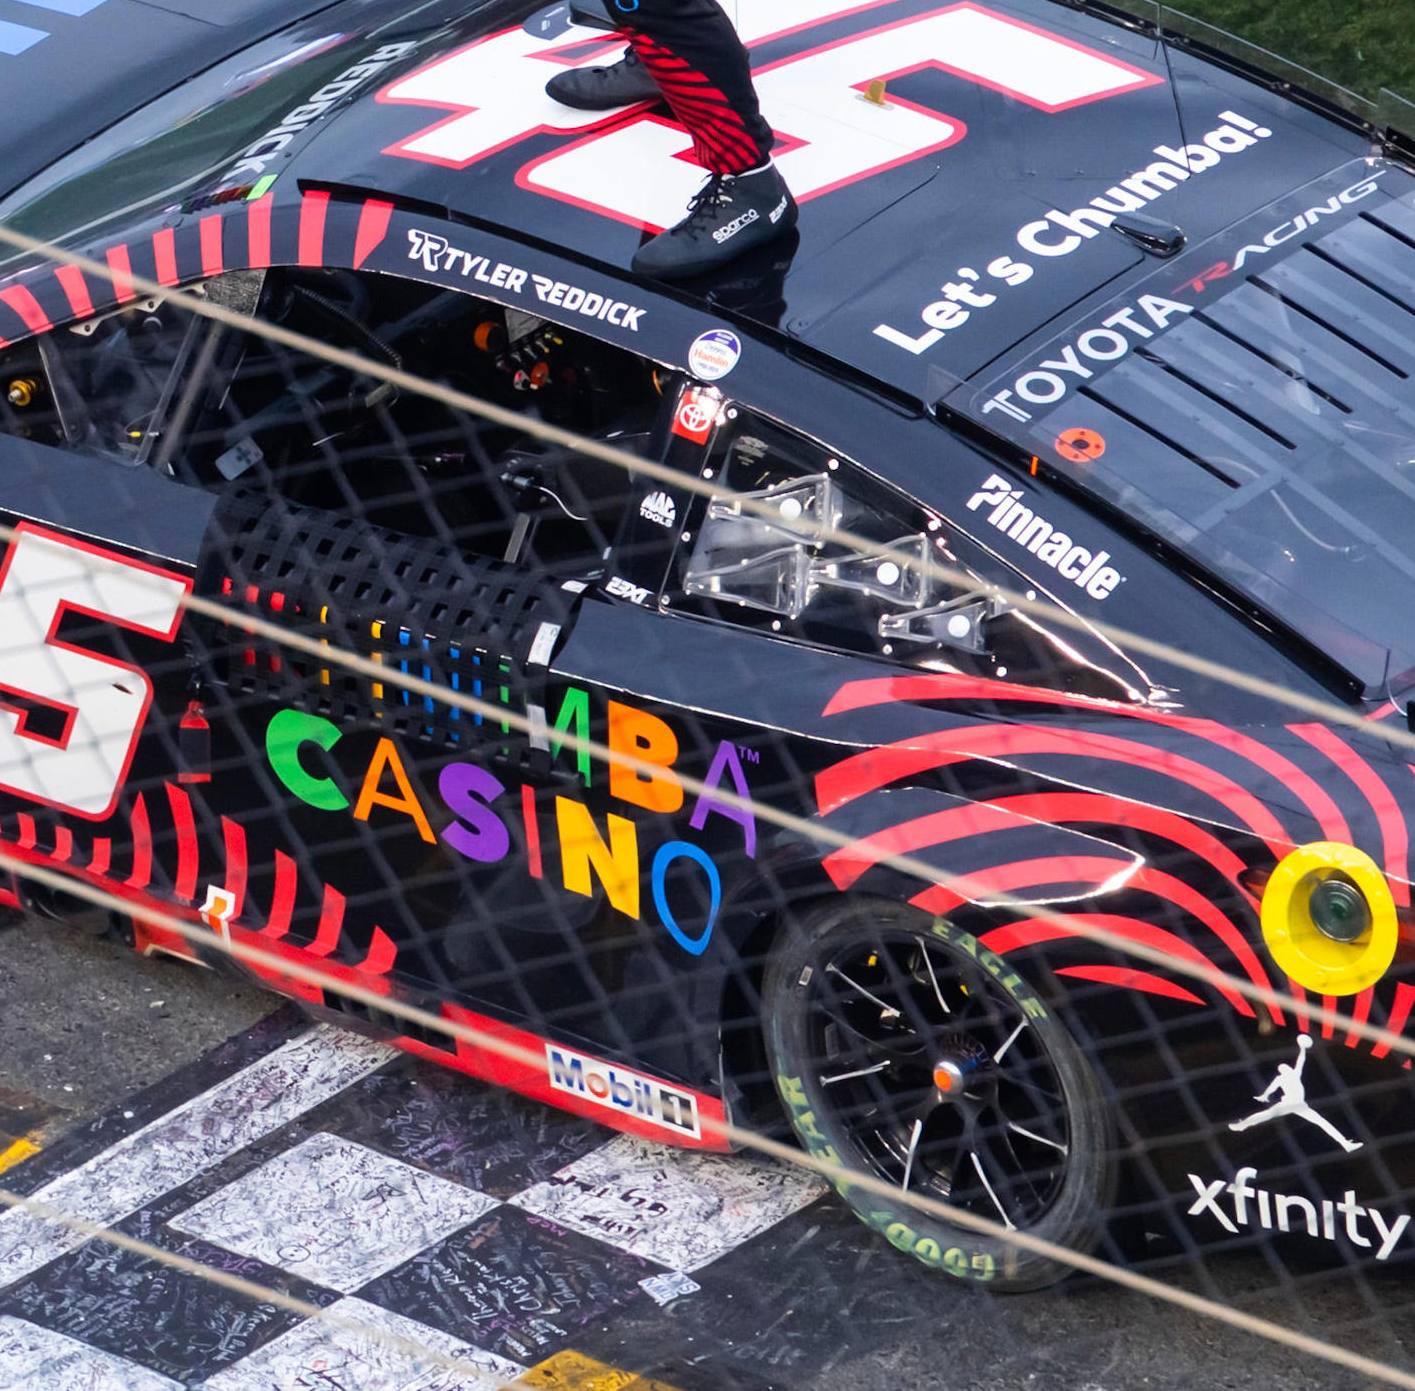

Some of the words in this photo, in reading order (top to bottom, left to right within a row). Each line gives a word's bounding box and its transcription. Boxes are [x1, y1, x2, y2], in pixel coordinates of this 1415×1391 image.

[219, 40, 418, 184] REDDICK
[712, 208, 760, 244] sparco
[871, 252, 1035, 356] Let's
[1015, 110, 1273, 258] Chumba!
[444, 246, 529, 294] TYLER
[530, 273, 648, 332] REDDICK
[981, 292, 1195, 425] TOYOTA
[1169, 168, 1387, 293] RACING
[639, 508, 674, 528] TOOLS
[640, 491, 676, 521] MAC
[965, 473, 1120, 601] Pinnacle
[265, 708, 722, 956] CASINO
[931, 914, 1050, 1021] EAGLE
[551, 1050, 654, 1117] Mobil
[1187, 1166, 1412, 1261] xfinity
